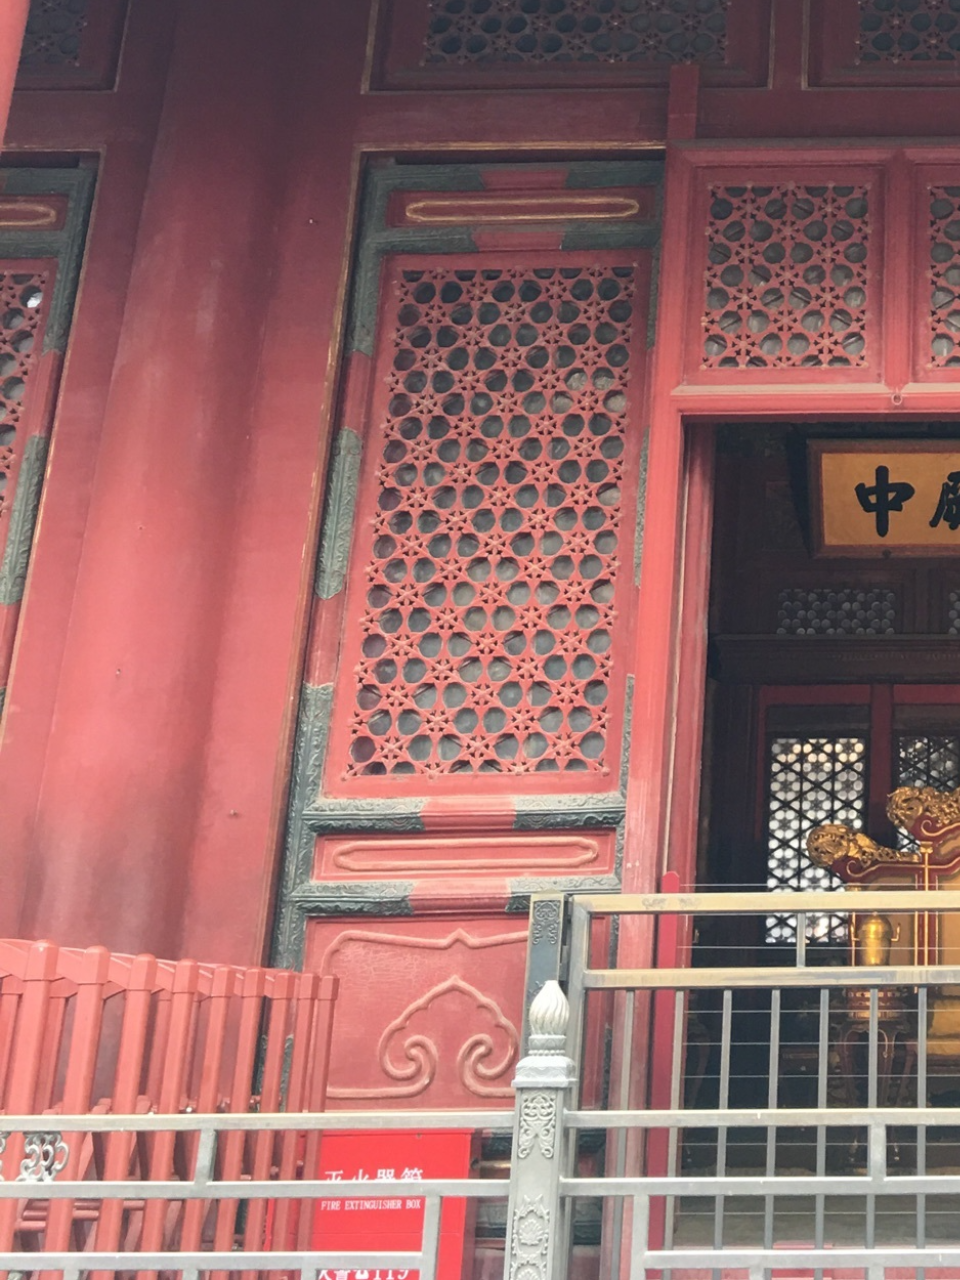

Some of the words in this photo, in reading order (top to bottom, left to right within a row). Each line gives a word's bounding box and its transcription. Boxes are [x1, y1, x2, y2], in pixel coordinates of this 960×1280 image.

[321, 1201, 341, 1211] FIRE
[345, 1200, 402, 1210] EXTINGUISHER
[406, 1199, 421, 1209] BOX
